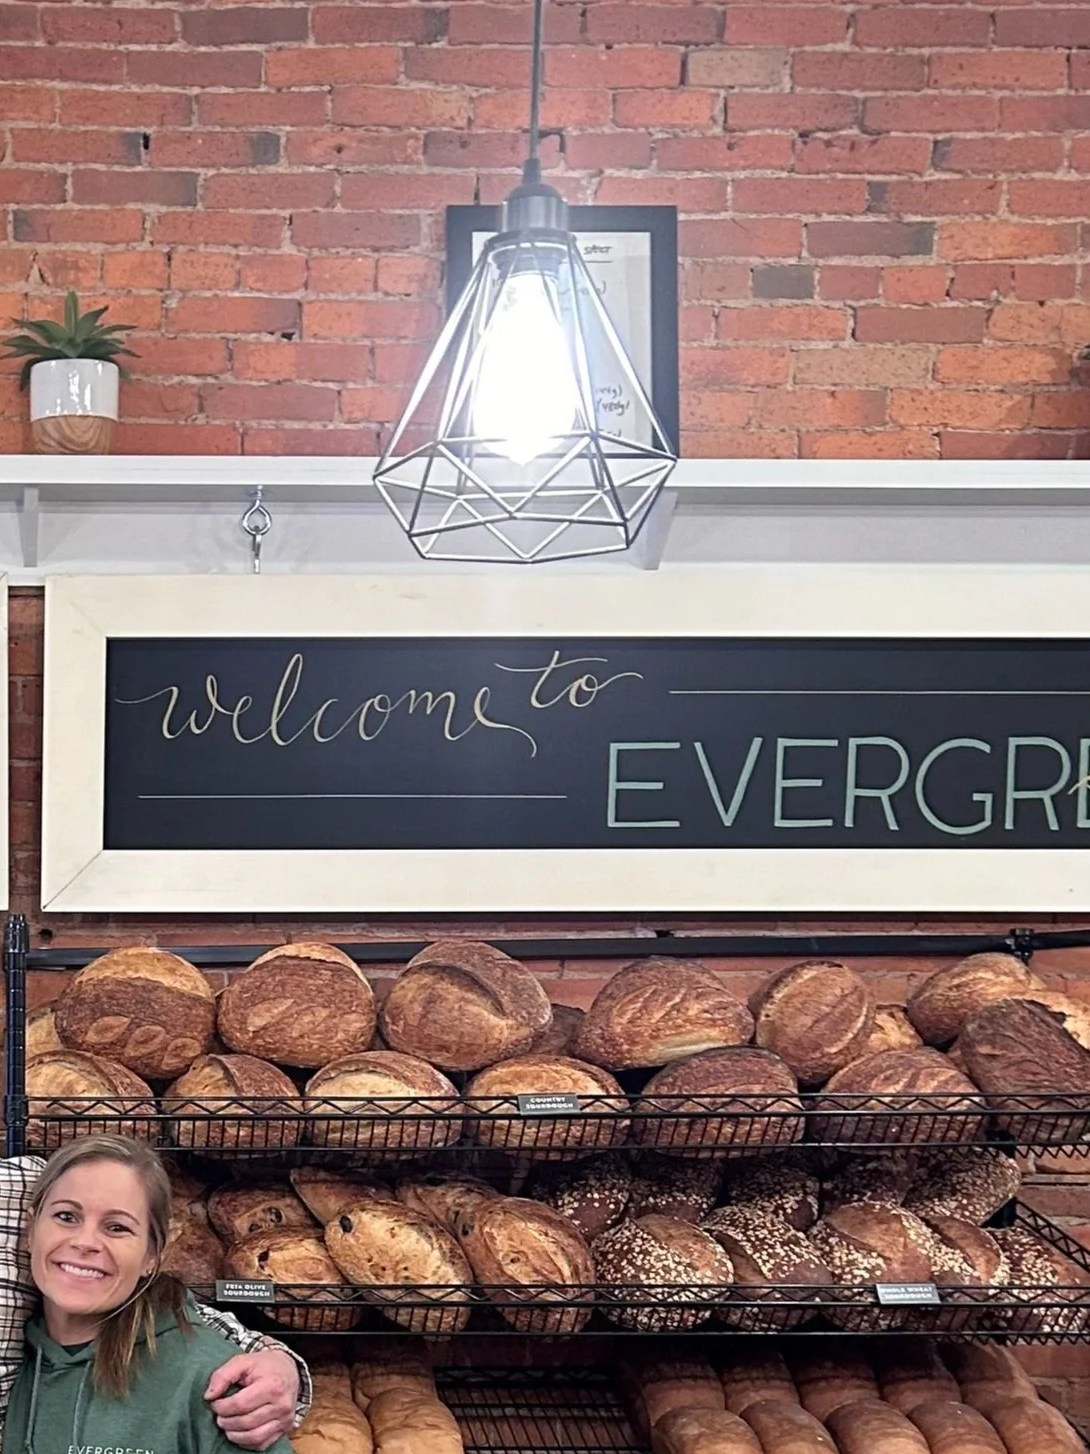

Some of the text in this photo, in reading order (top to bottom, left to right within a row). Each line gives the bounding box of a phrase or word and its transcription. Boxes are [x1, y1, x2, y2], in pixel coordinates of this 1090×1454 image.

[114, 650, 644, 758] welcome to
[607, 736, 1090, 835] EVERGR
[223, 1290, 270, 1298] SOURDOUGH
[244, 1283, 266, 1291] OLIVE
